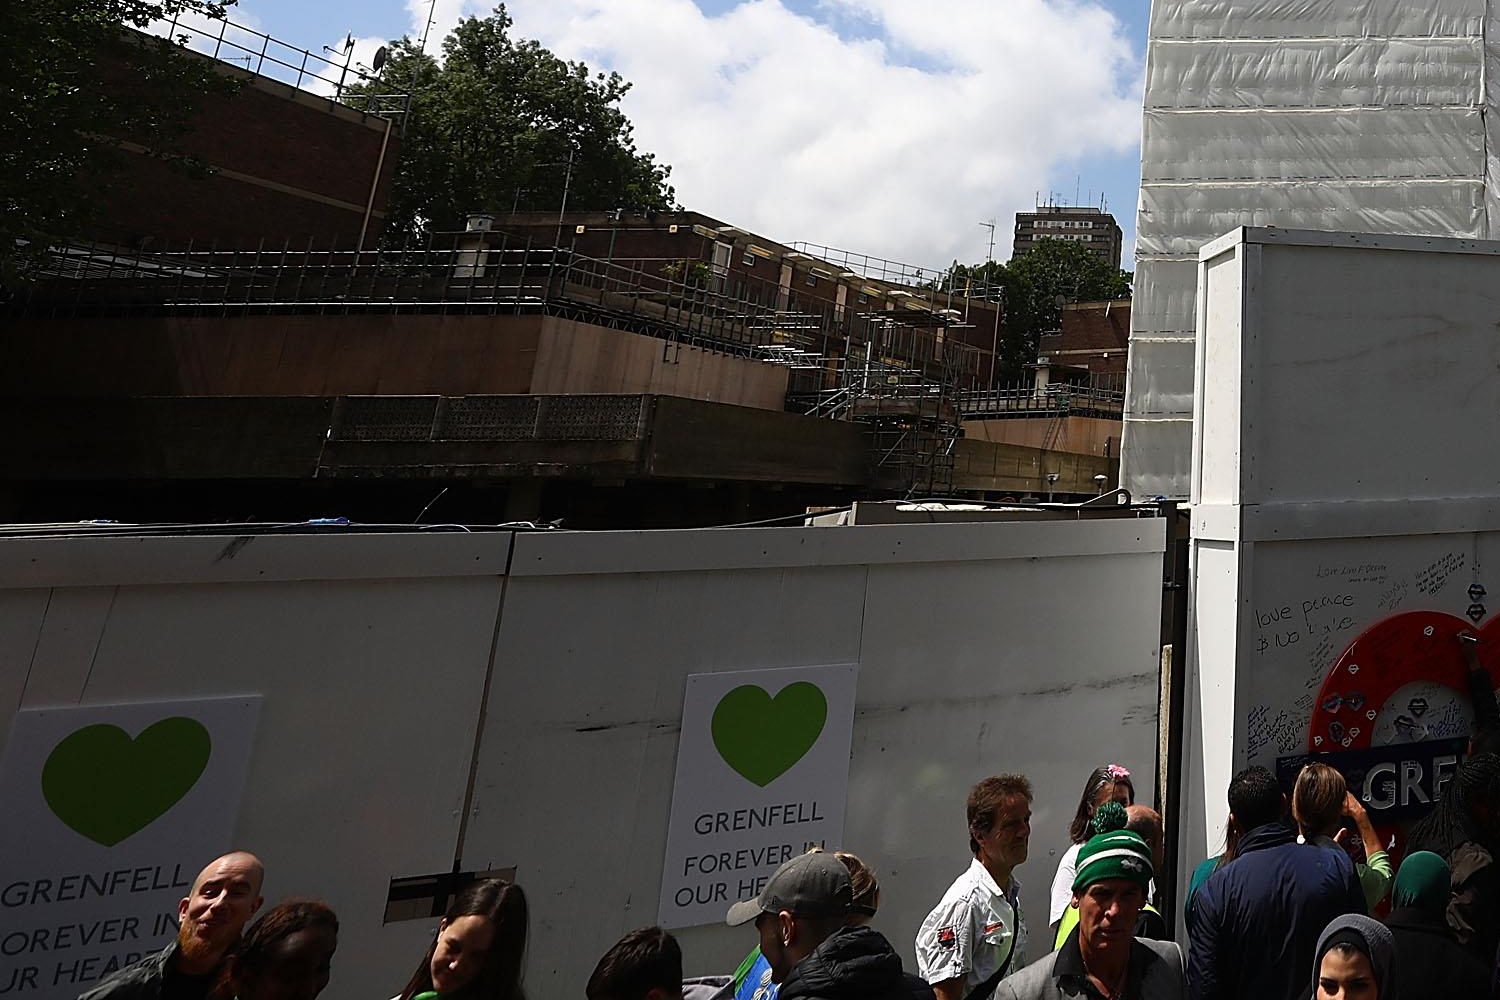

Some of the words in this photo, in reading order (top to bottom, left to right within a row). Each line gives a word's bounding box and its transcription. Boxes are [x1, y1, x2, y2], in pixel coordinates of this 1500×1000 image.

[694, 801, 824, 835] GRENFELL
[684, 844, 793, 876] FOREVER
[0, 863, 190, 908] GRENFELL
[674, 882, 728, 907] OUR
[0, 917, 140, 956] OREVER
